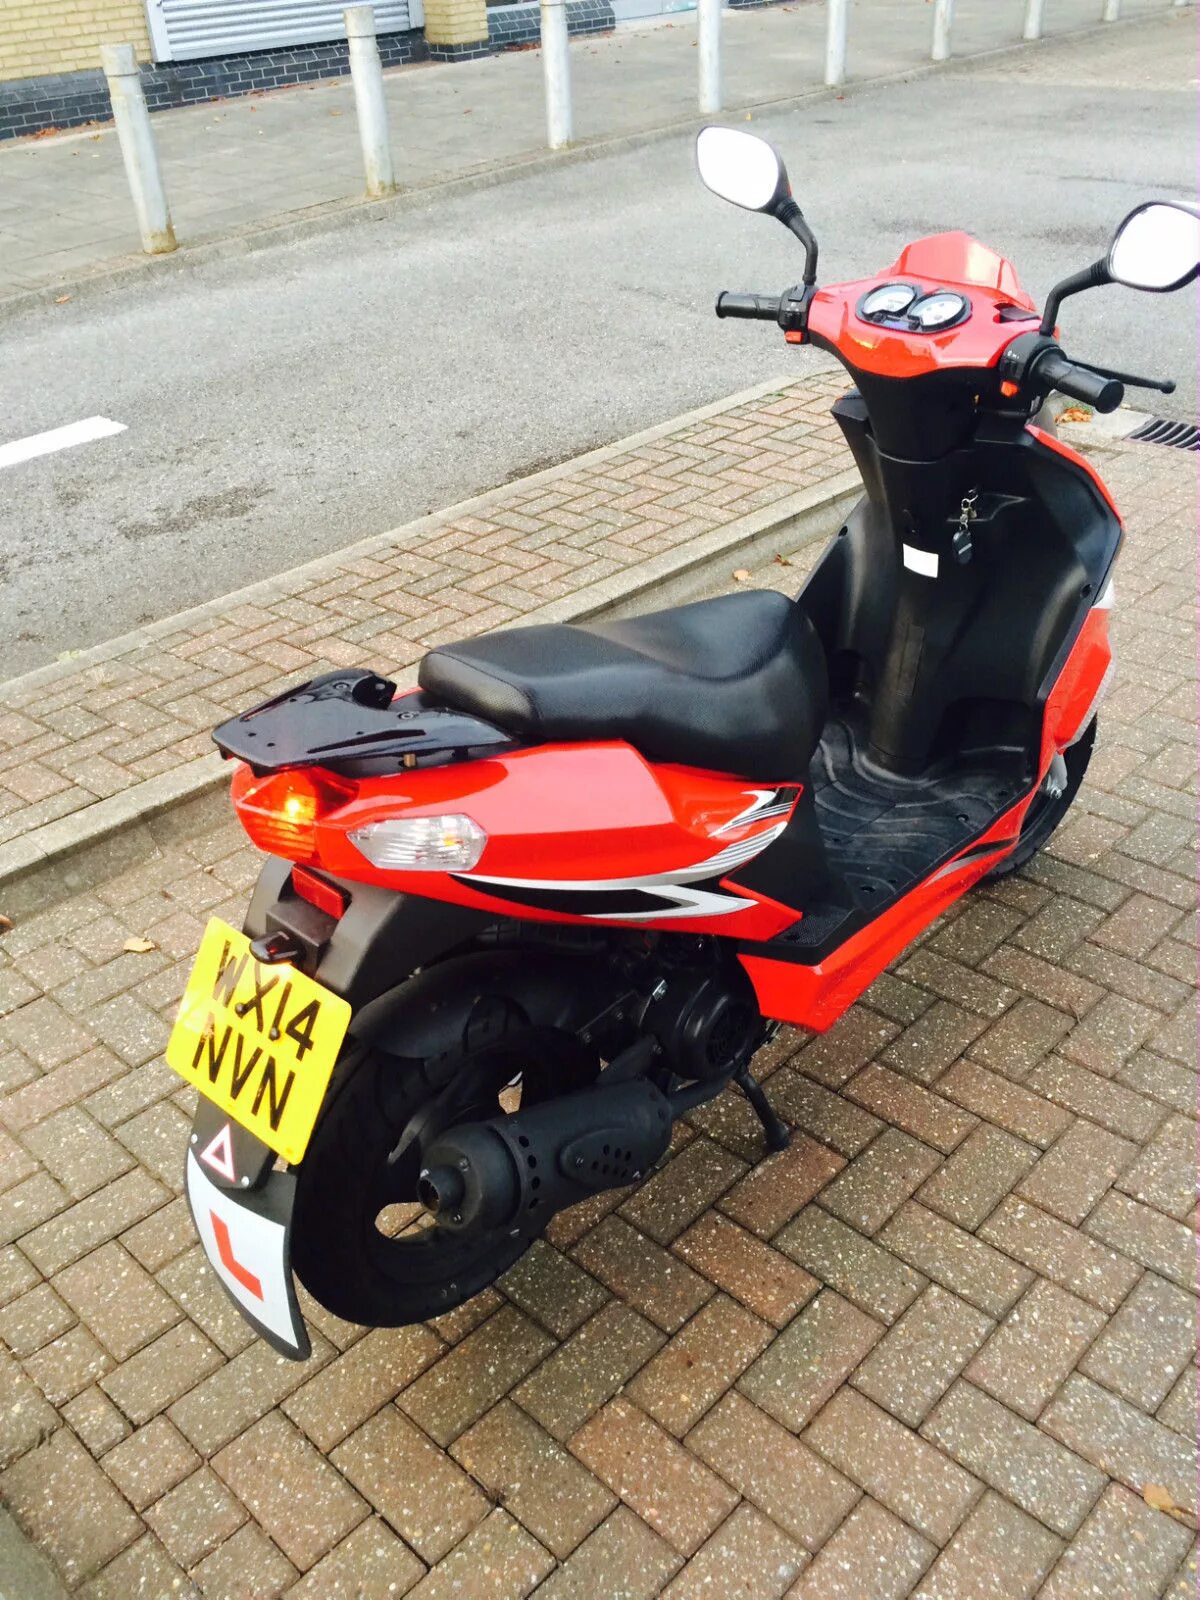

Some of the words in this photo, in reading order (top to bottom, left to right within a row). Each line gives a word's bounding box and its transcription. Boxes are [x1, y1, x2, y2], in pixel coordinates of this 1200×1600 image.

[212, 940, 321, 1061] WX14
[192, 1012, 295, 1131] NVN
[209, 1209, 263, 1302] L
